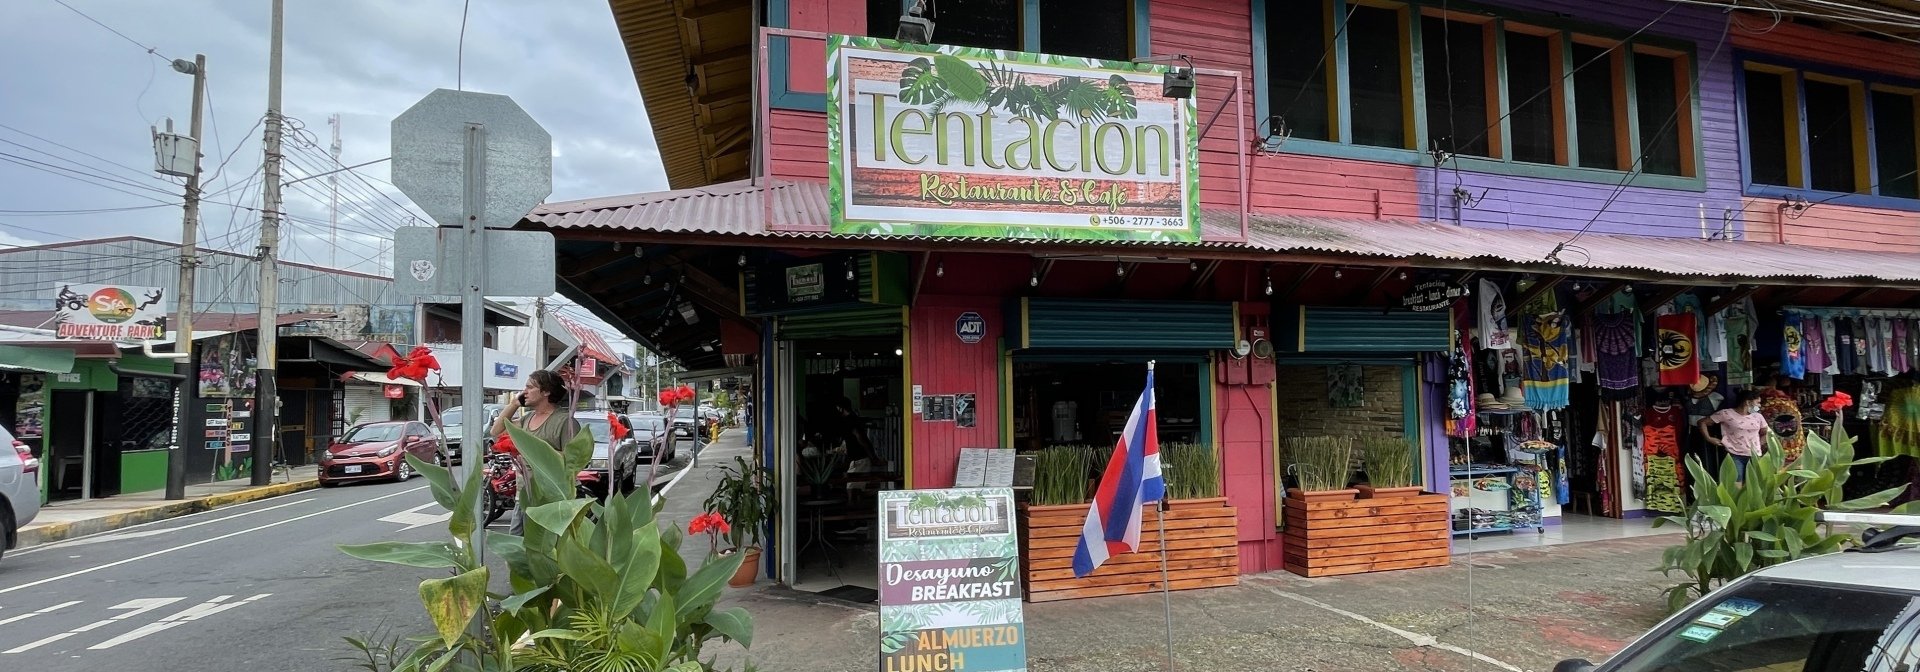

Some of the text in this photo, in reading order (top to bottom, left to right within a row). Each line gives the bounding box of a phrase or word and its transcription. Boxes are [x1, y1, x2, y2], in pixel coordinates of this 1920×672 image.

[920, 172, 1128, 214] Restaurante & Café
[1102, 216, 1125, 226] +506
[1133, 217, 1155, 226] 2777
[1161, 218, 1184, 227] 3663
[59, 323, 155, 337] ADVENTURE PARK
[960, 321, 982, 334] ADT
[886, 563, 995, 586] Desayuno
[911, 580, 1015, 602] BREAKFAST
[917, 625, 1019, 651] ALMUERZO
[886, 651, 965, 672] LUNCH
